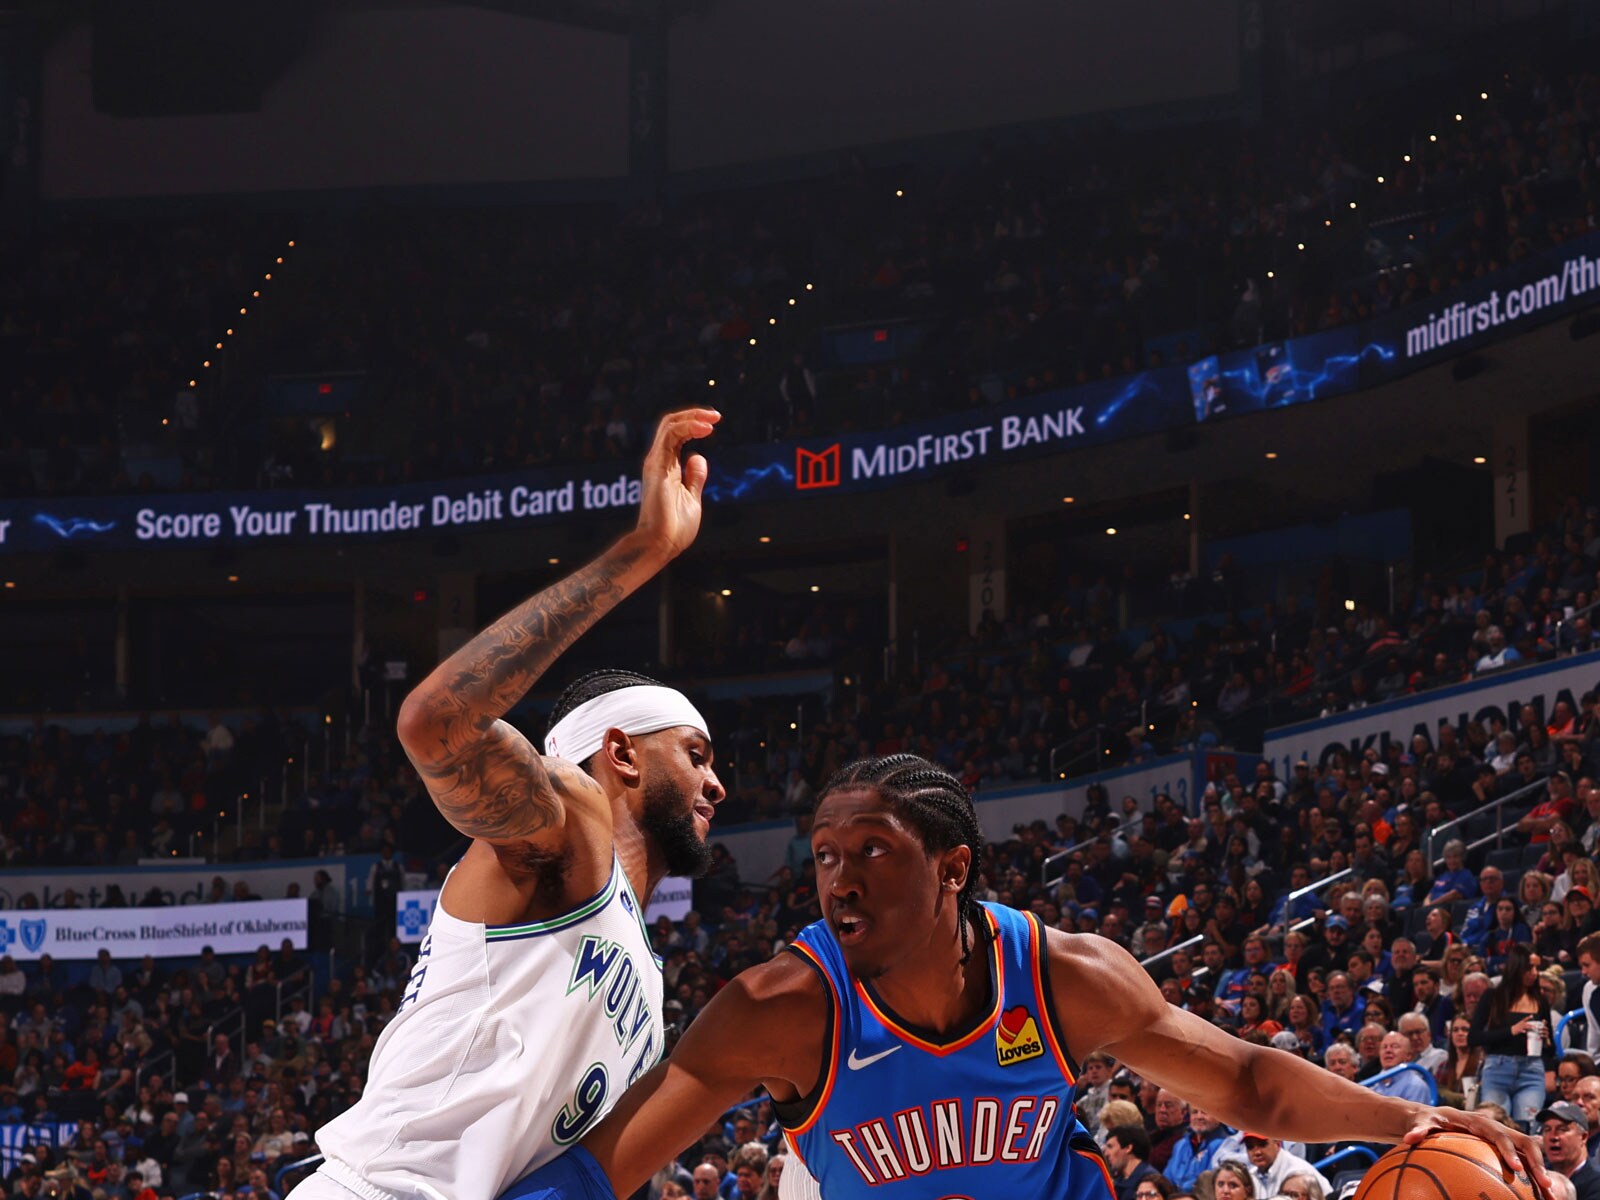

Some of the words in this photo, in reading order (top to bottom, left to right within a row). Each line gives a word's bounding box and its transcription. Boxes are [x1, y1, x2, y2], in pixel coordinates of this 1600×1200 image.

[136, 509, 219, 539] Score
[230, 506, 295, 536] Your
[305, 499, 424, 534] Thunder
[432, 490, 502, 527] Debit
[510, 482, 573, 518] Card
[582, 477, 641, 509] toda
[55, 926, 136, 942] BlueCross
[140, 921, 217, 940] BlueShield
[219, 920, 234, 935] of
[236, 917, 308, 934] Oklahoma
[829, 1096, 1059, 1187] THUNDER
